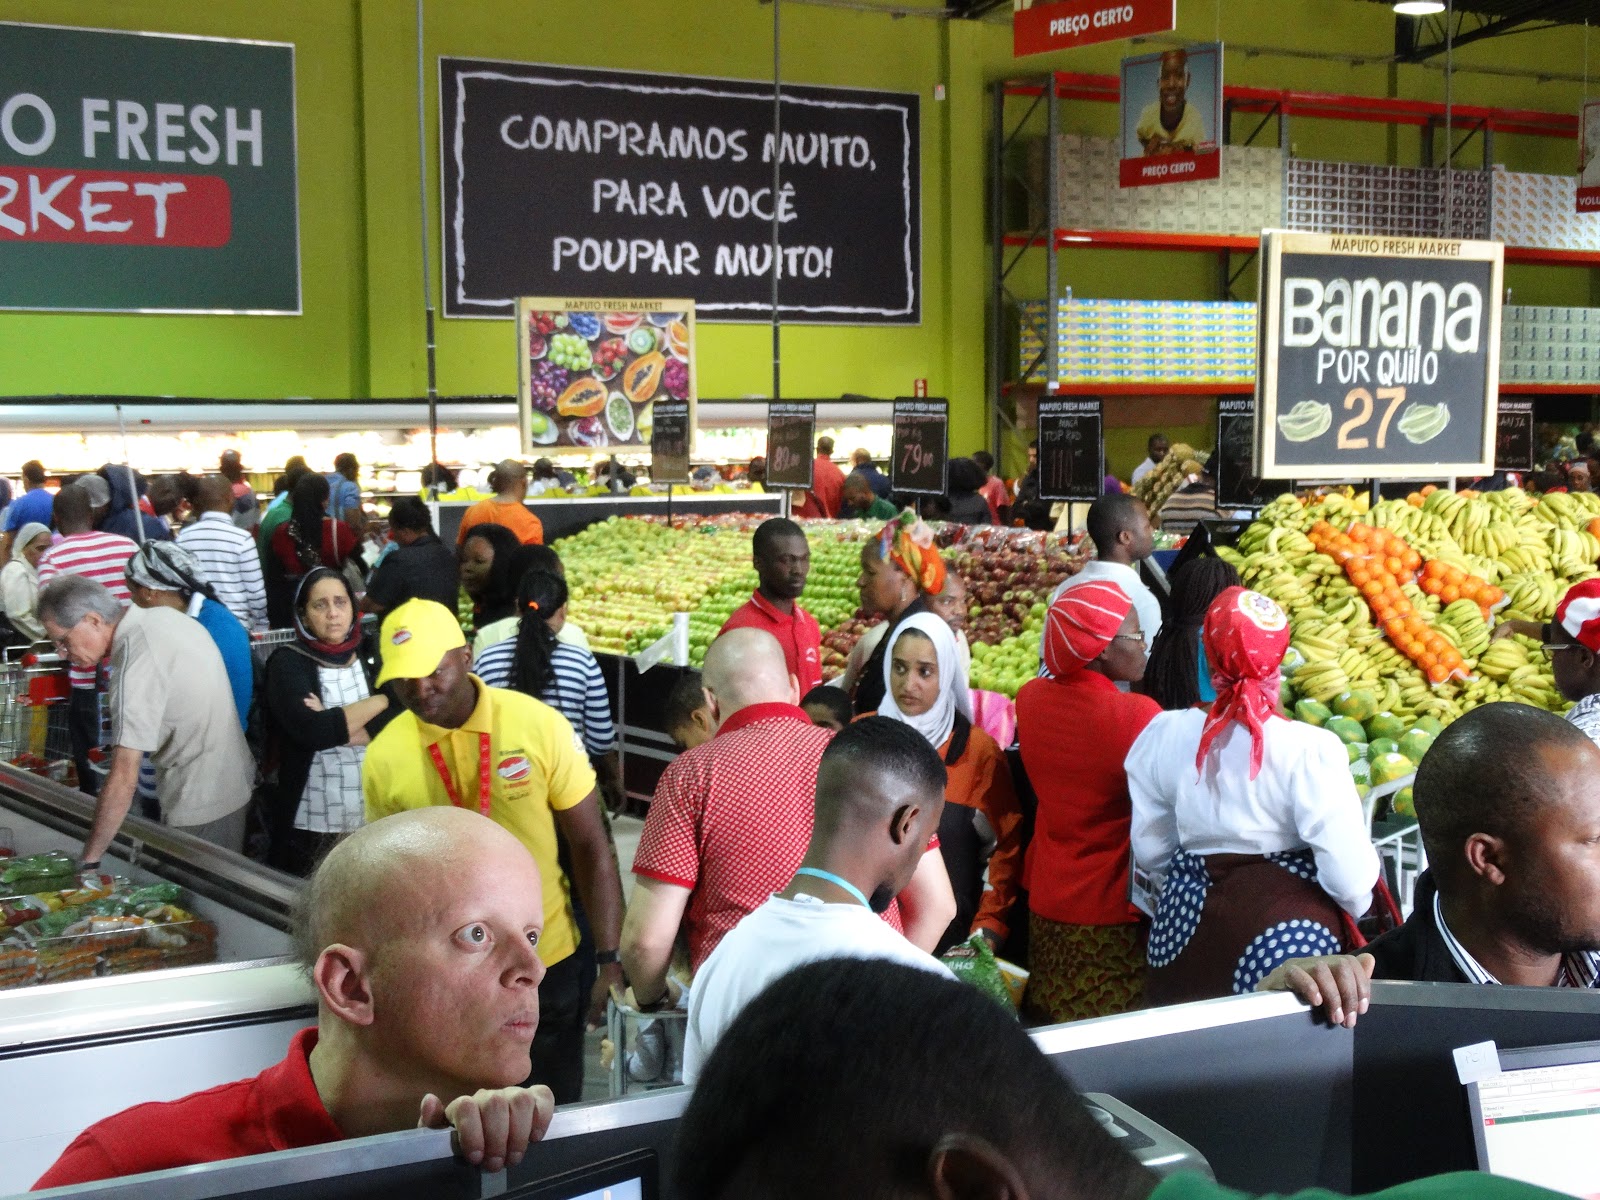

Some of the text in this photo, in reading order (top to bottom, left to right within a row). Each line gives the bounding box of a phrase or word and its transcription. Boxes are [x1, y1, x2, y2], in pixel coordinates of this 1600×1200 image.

[1050, 5, 1133, 36] PREÇO CERTO
[2, 93, 263, 167] O FRESH
[501, 115, 876, 170] COMPRAMOS MUITO,
[1142, 162, 1195, 178] PREÇO CERTO
[593, 179, 798, 222] PARA VOCÊ
[553, 237, 833, 278] POUPAR MUITO!
[1331, 239, 1461, 256] MAPUTO FRESH MARKET
[565, 301, 663, 312] MAPUTO FRESH MARKET
[1317, 349, 1370, 385] POR
[1040, 401, 1099, 411] MAPUTO FRESH MARKET
[1220, 401, 1246, 410] MAPUTO
[1337, 386, 1406, 449] 27
